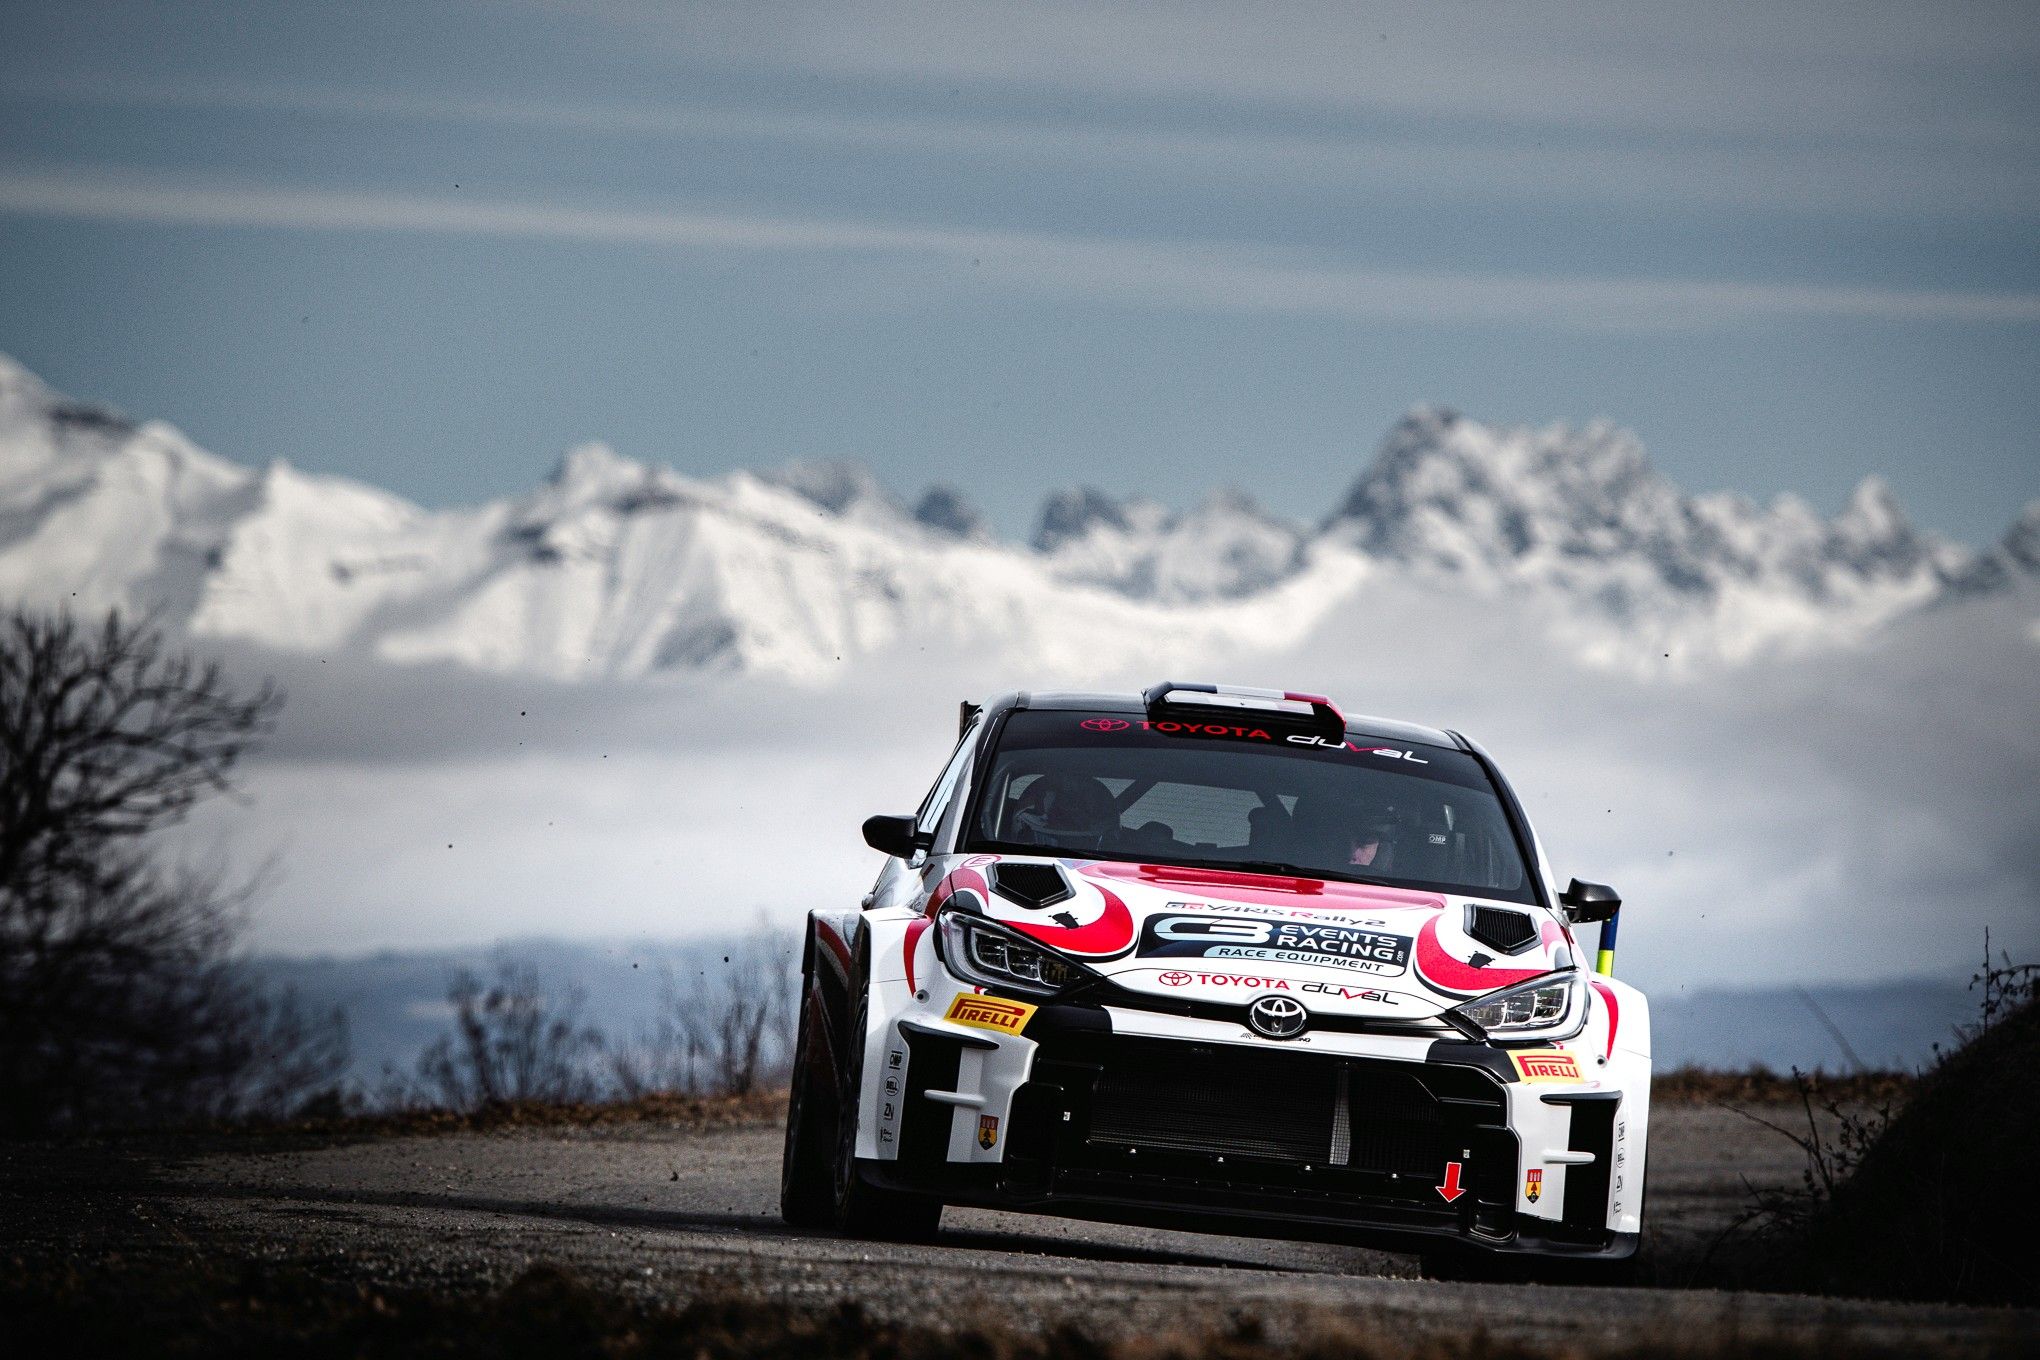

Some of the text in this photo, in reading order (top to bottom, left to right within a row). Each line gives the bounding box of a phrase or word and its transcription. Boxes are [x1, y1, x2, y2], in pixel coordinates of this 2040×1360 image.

[1136, 720, 1272, 740] TOYOTA
[1207, 903, 1285, 916] YARIS
[1276, 934, 1395, 961] RACING
[1280, 924, 1398, 948] EVENTS
[1218, 948, 1384, 972] RACE EQUIPMENT
[1197, 974, 1290, 991] TOYOTA
[950, 998, 1026, 1028] PIRELLI
[1516, 1055, 1580, 1079] PIRELLI
